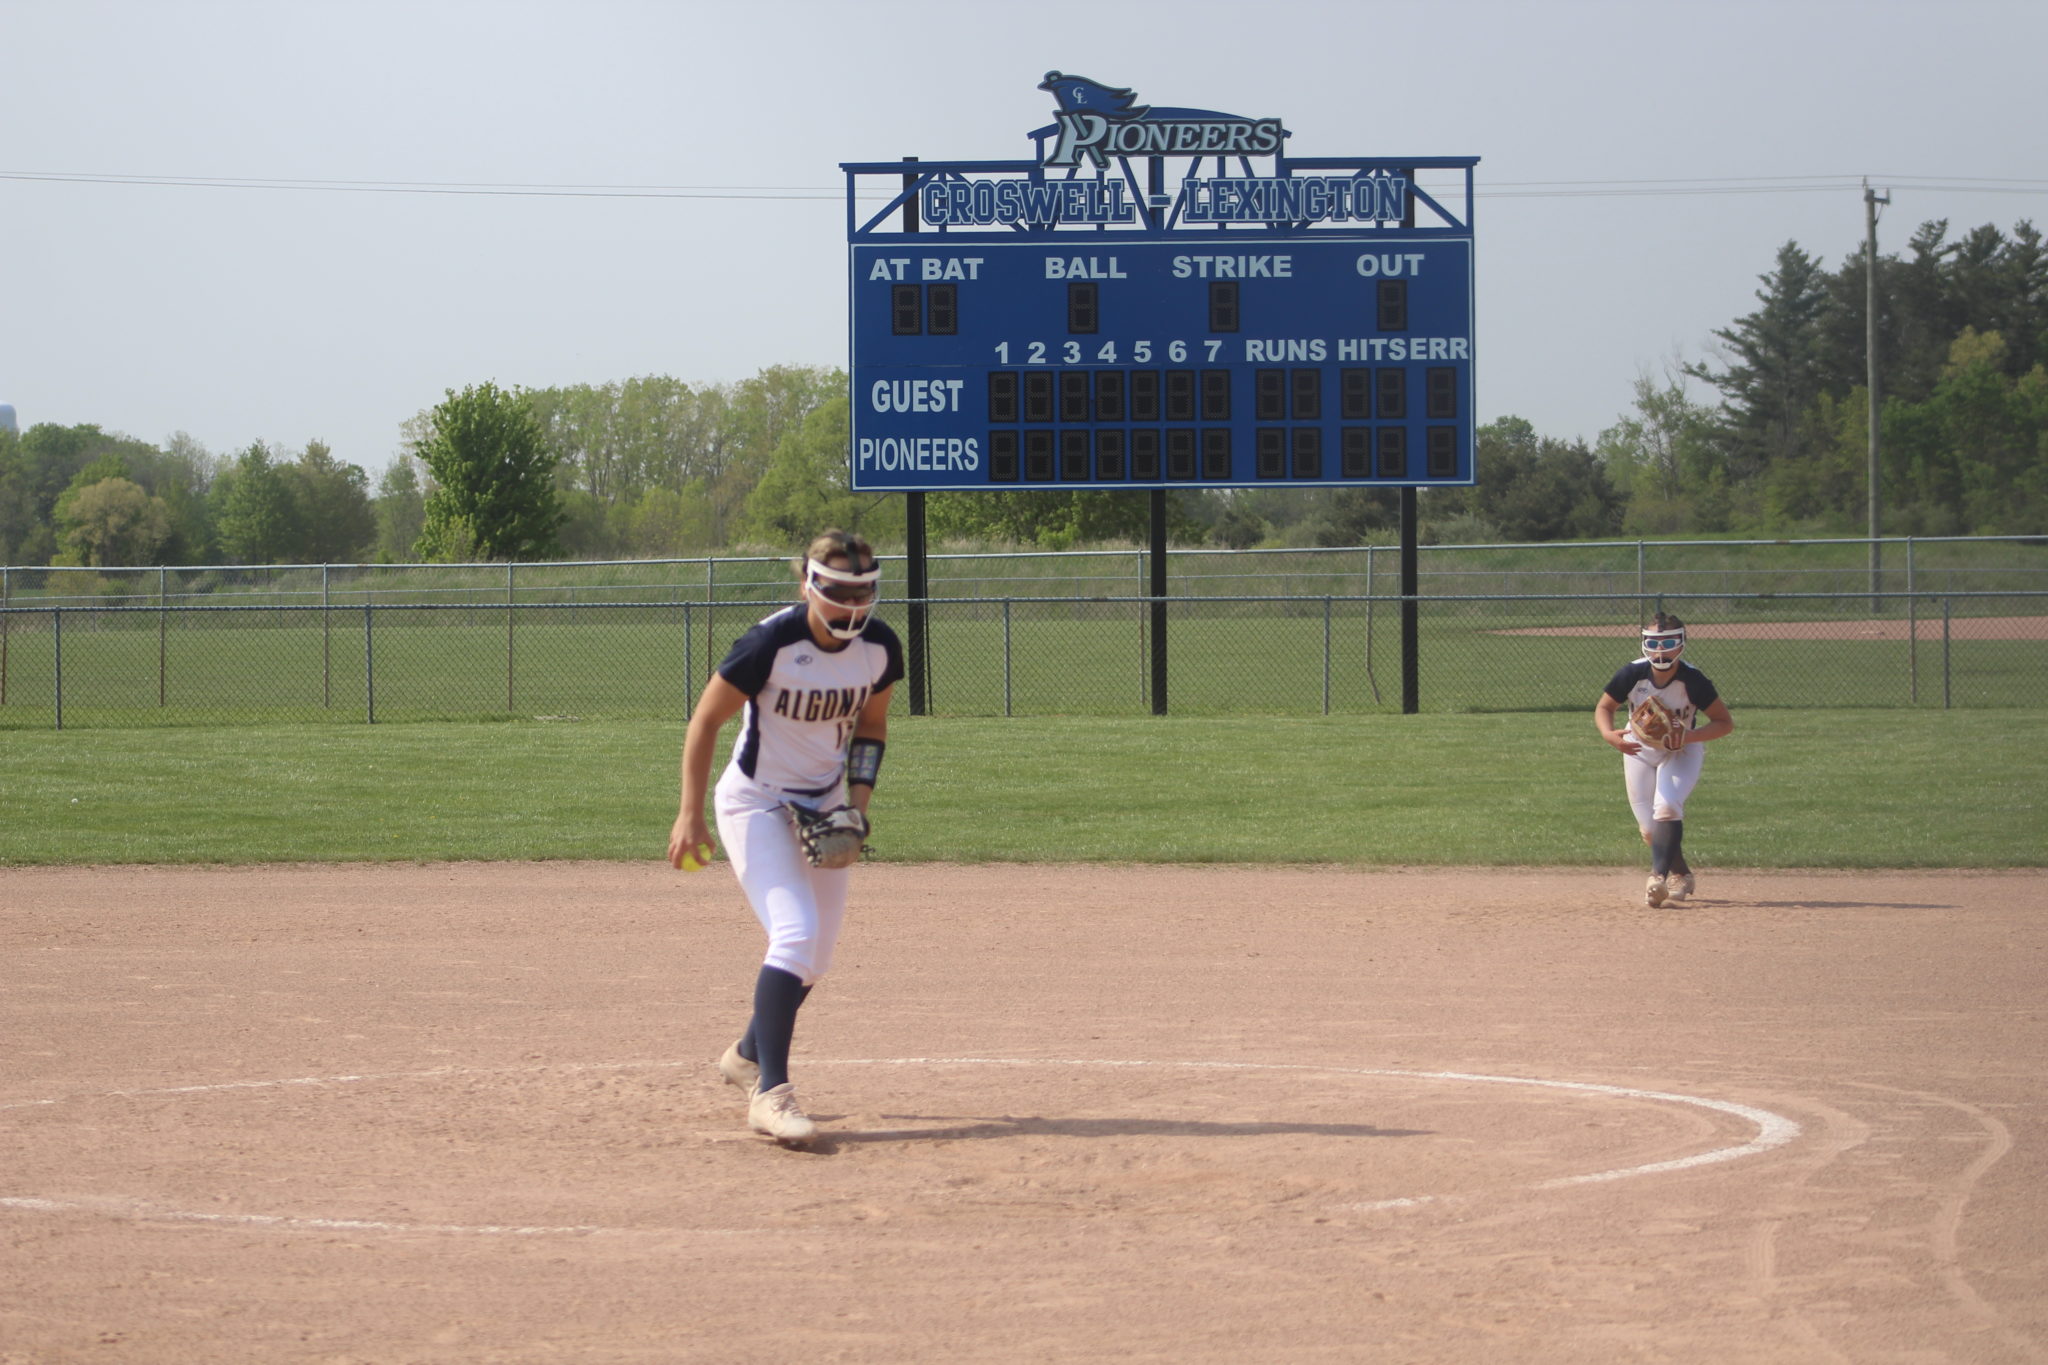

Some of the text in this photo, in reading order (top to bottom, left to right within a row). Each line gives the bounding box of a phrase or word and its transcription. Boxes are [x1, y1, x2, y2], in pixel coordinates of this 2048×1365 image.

[1041, 114, 1279, 168] PIONEERS
[922, 180, 1136, 225] CROSWELL
[1183, 177, 1406, 222] LEXINGTON
[870, 257, 984, 281] AT BAT
[1045, 256, 1127, 279] BALL
[1172, 255, 1292, 278] STRIKE
[1356, 253, 1425, 276] OUT
[994, 337, 1468, 364] 1 2 3 4 5 6 7 RUNS HITS ERR
[871, 379, 964, 413] GUEST
[859, 437, 979, 471] PIONEERS
